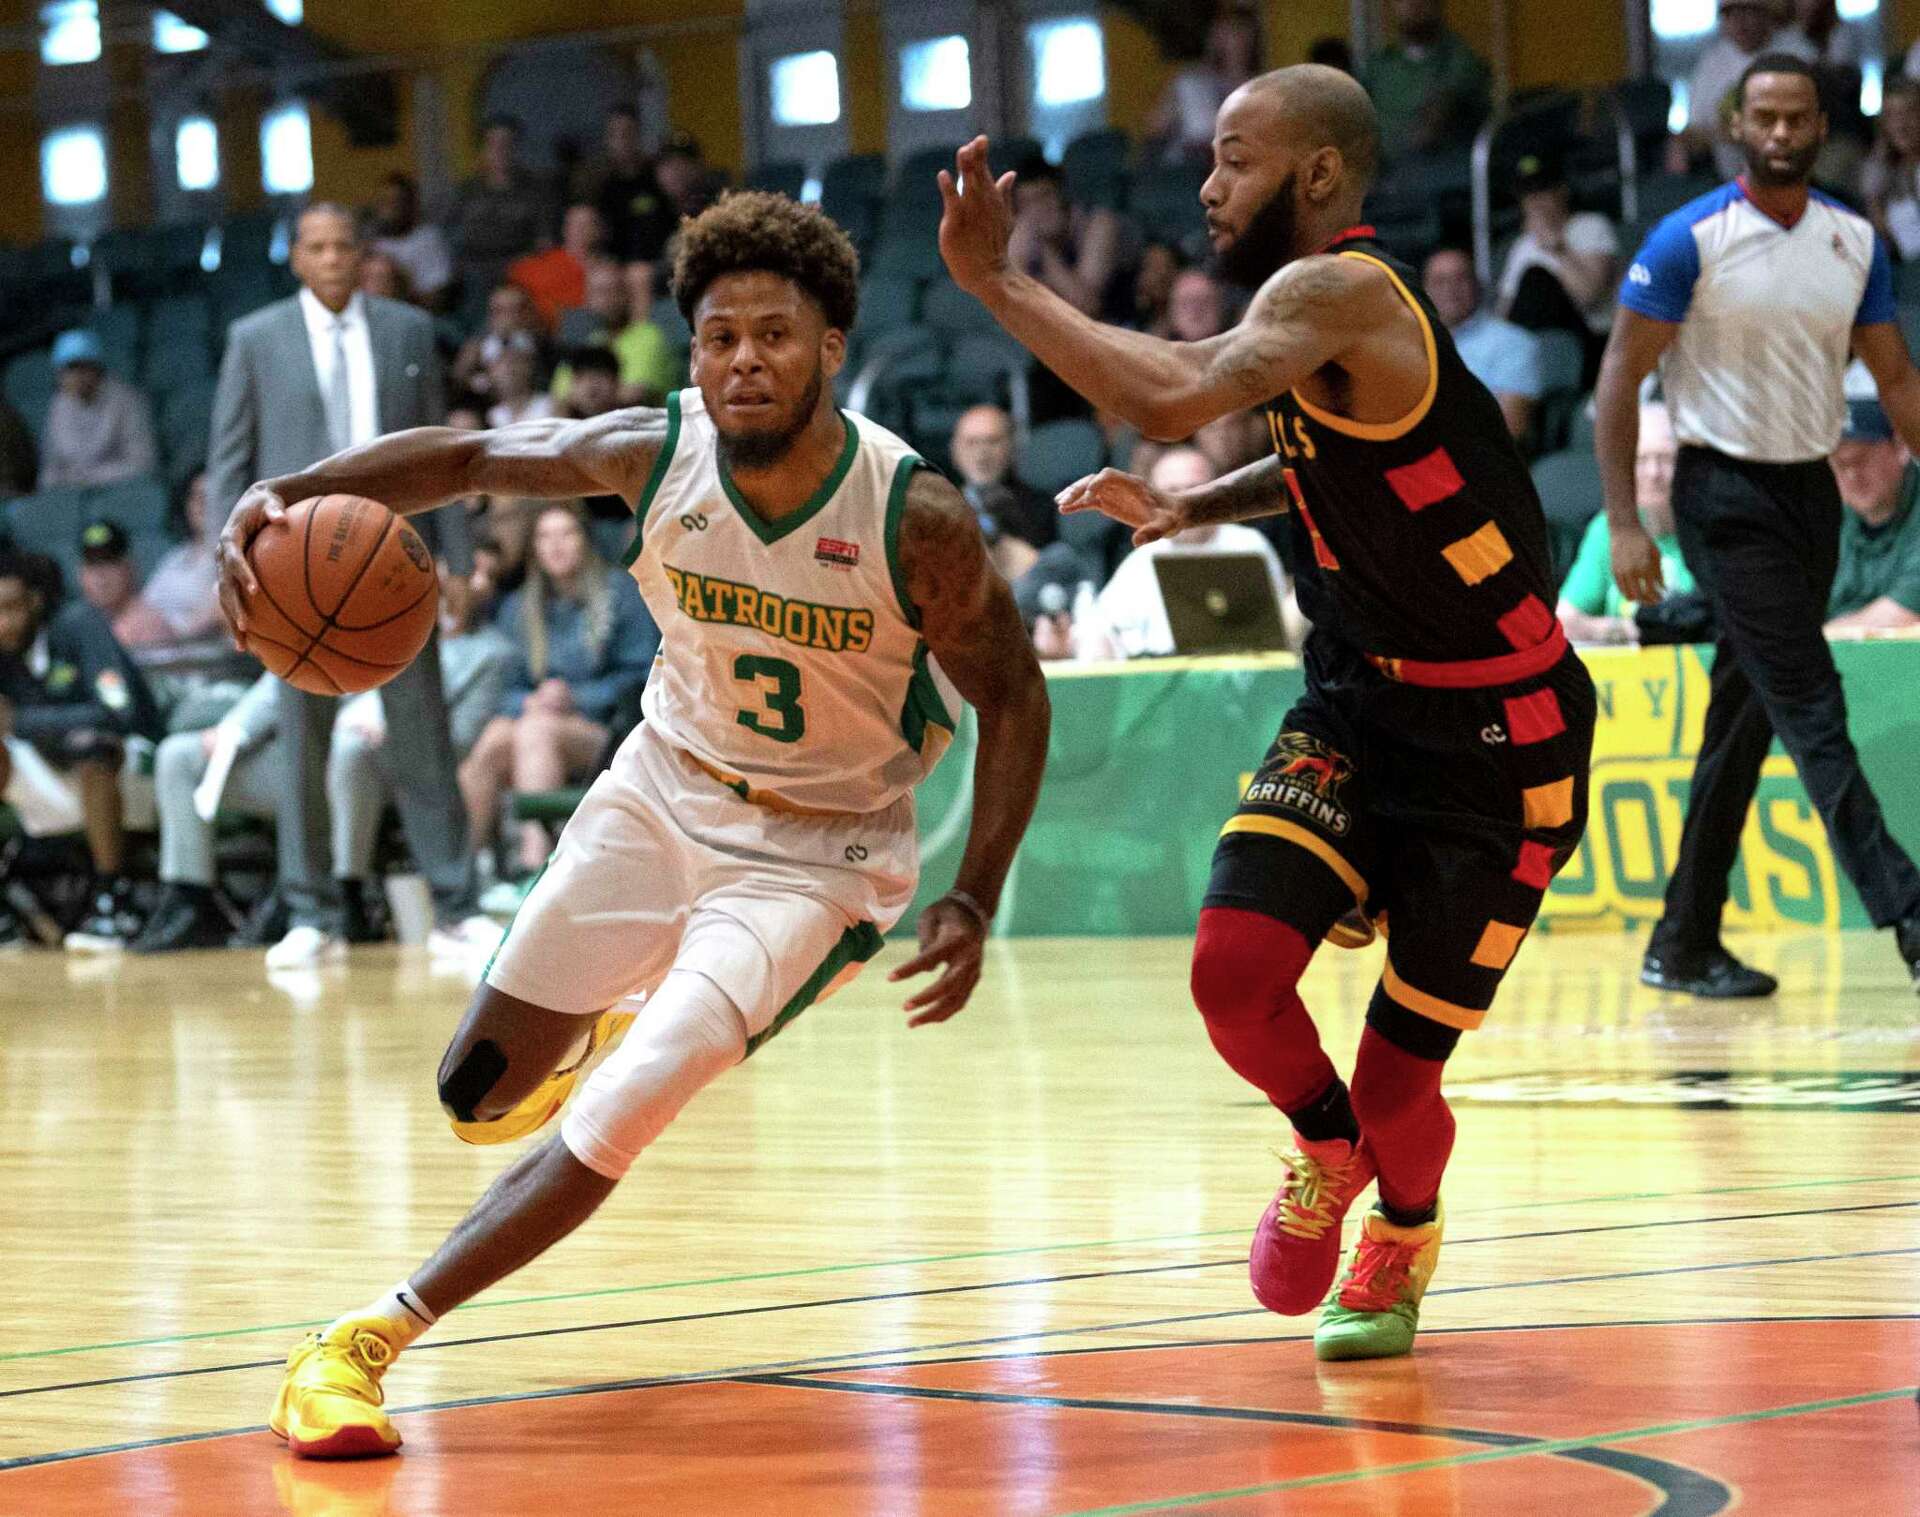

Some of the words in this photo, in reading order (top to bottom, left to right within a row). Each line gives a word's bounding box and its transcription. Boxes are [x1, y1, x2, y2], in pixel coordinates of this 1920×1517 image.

[816, 537, 860, 556] ESPN
[733, 654, 805, 743] 3
[1246, 782, 1347, 832] GRIFFINS
